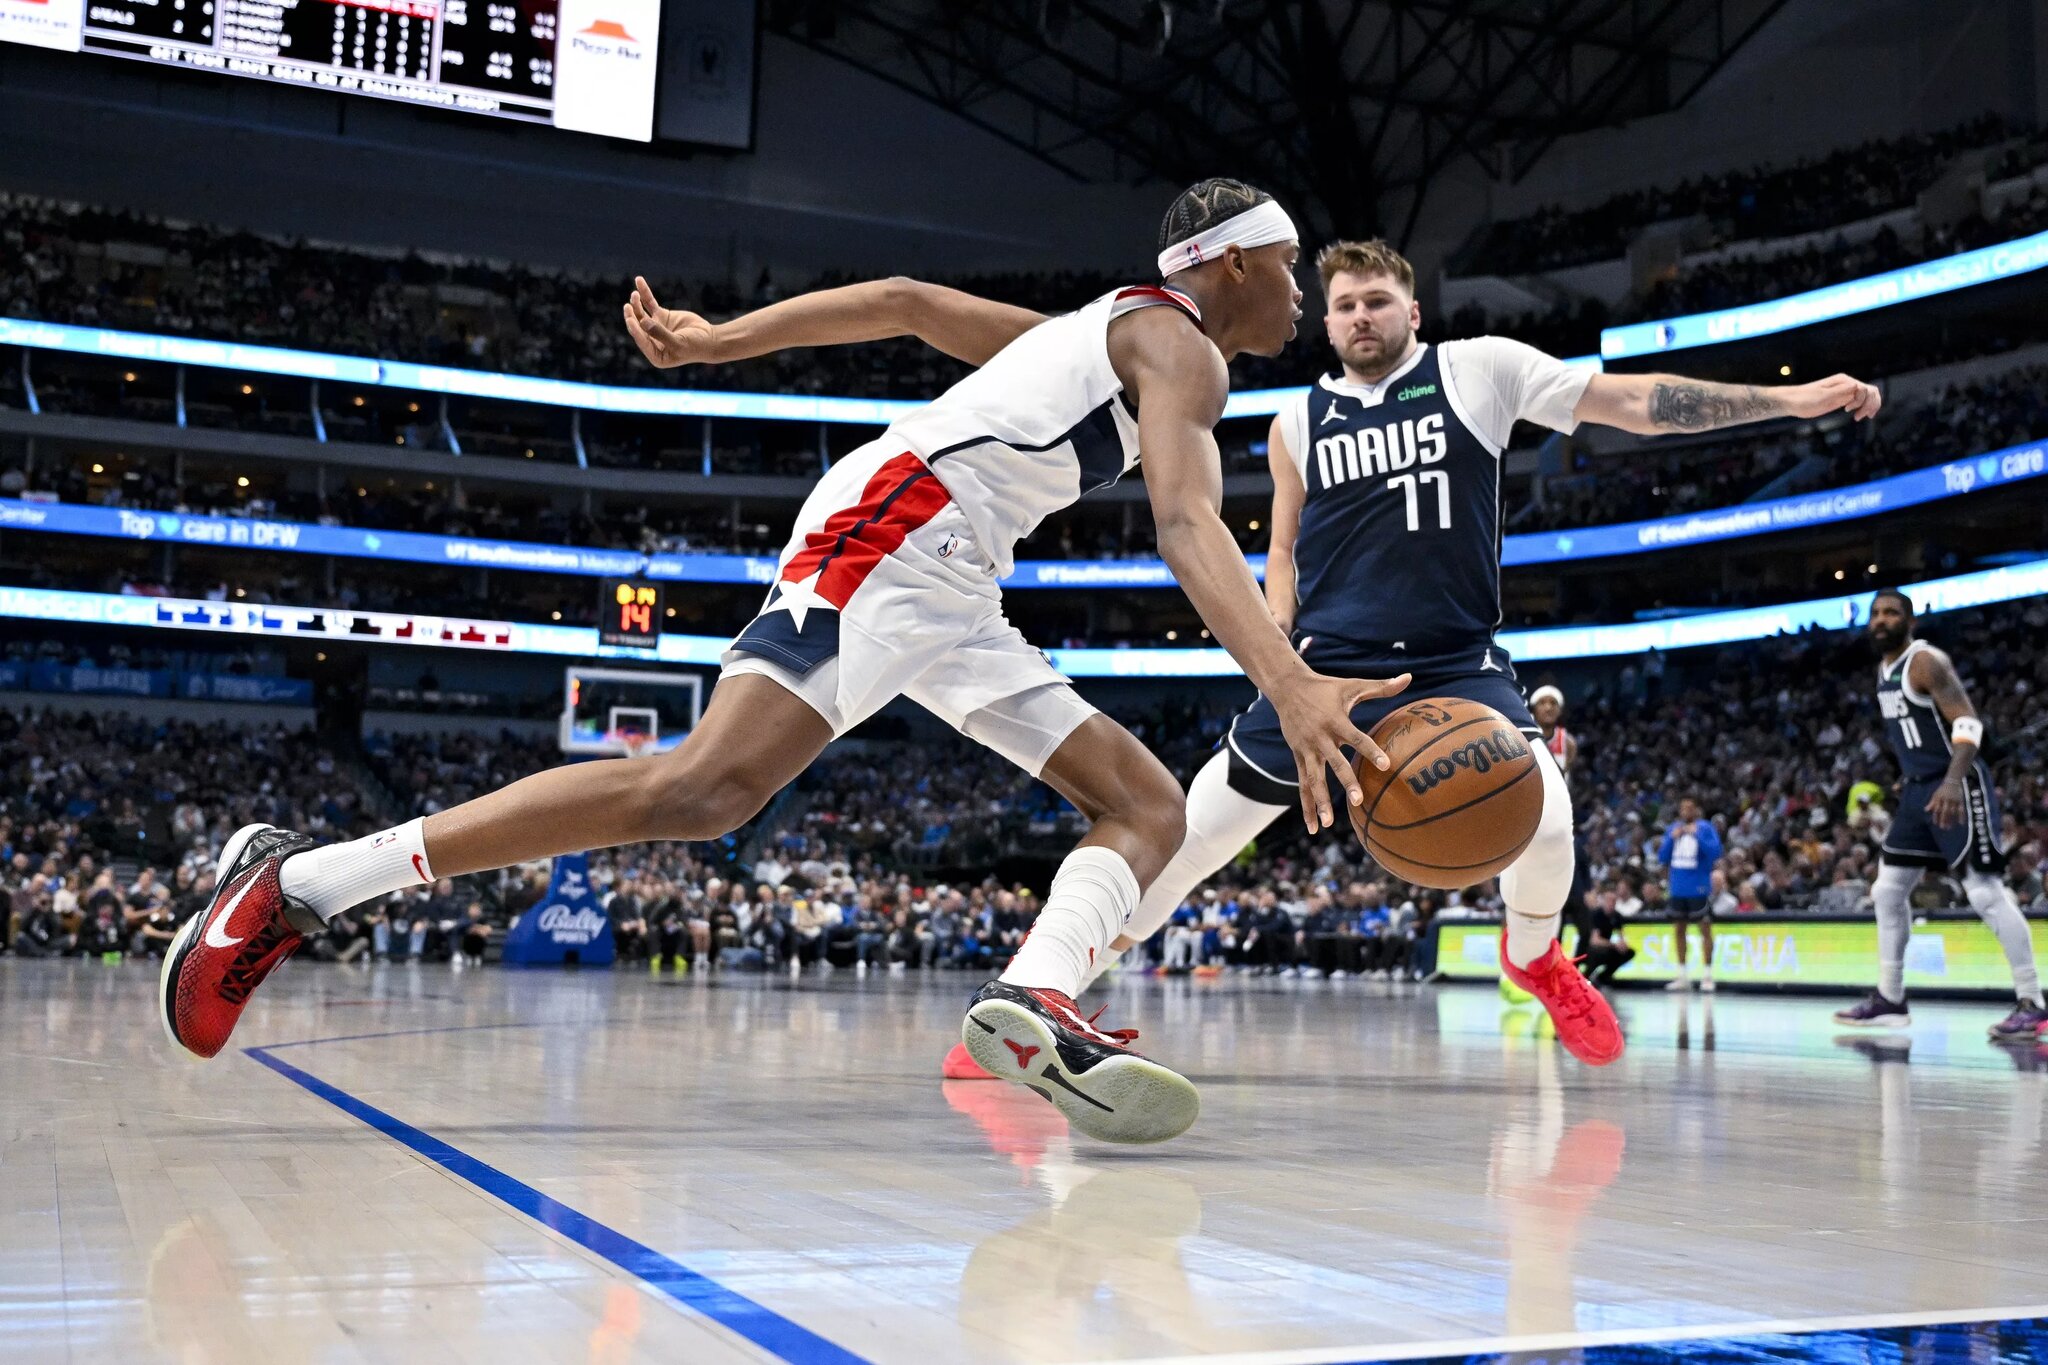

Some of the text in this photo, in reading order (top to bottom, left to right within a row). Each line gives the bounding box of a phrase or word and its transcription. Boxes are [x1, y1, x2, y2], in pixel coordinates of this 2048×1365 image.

[1397, 383, 1437, 401] chime
[1315, 413, 1447, 490] MAVS
[1941, 448, 2044, 494] Top care
[1387, 469, 1451, 532] 77
[1637, 489, 1883, 546] UT Southwestern Medical Center
[119, 510, 300, 549] Top care in DFW
[621, 603, 650, 633] 14
[1898, 717, 1922, 749] 11
[1406, 728, 1529, 795] Wilson
[538, 903, 607, 940] Bally
